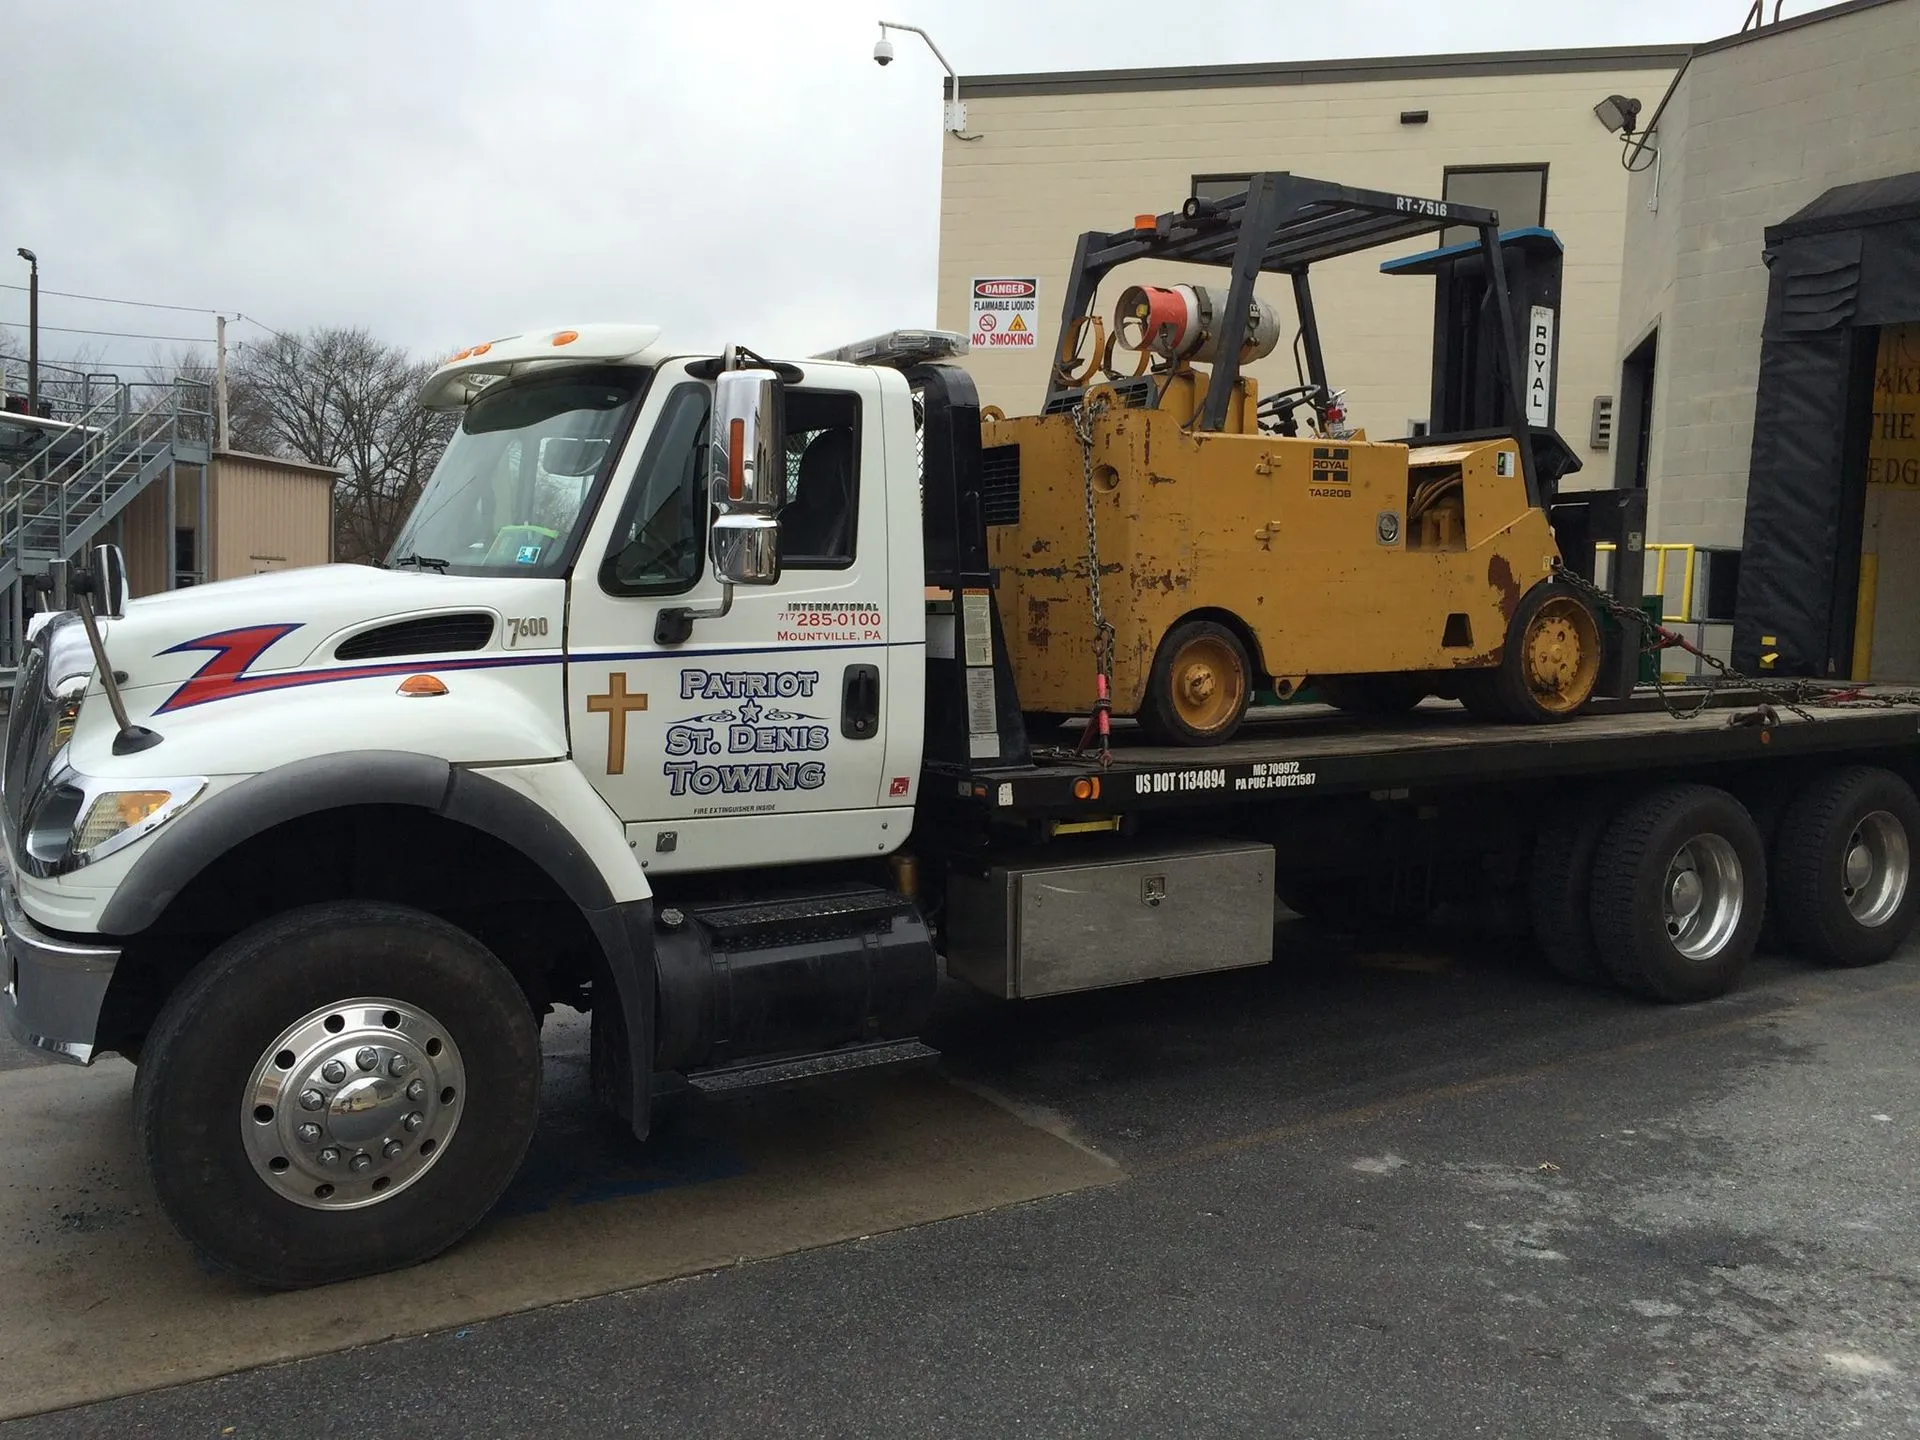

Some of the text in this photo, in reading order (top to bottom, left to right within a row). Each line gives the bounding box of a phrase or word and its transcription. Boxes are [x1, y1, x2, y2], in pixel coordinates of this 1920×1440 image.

[1396, 196, 1447, 217] RT-7516
[985, 284, 1024, 294] DANGER
[974, 301, 1035, 311] FLAMMABLE LIQUIDS
[972, 333, 1034, 346] NO SMOKING
[1532, 325, 1547, 407] ROYAL
[1876, 368, 1920, 395] AK
[1312, 460, 1349, 470] ROYAL
[788, 602, 879, 612] INTERNATIONAL
[778, 613, 881, 626] 717 285-0100
[507, 616, 548, 647] 7600
[864, 630, 881, 640] PA
[1253, 761, 1300, 776] MC 709972
[1135, 769, 1226, 794] US DOT 1134894
[1235, 773, 1316, 790] PA PUC A-00121587
[709, 805, 755, 814] EXTINGUISHER
